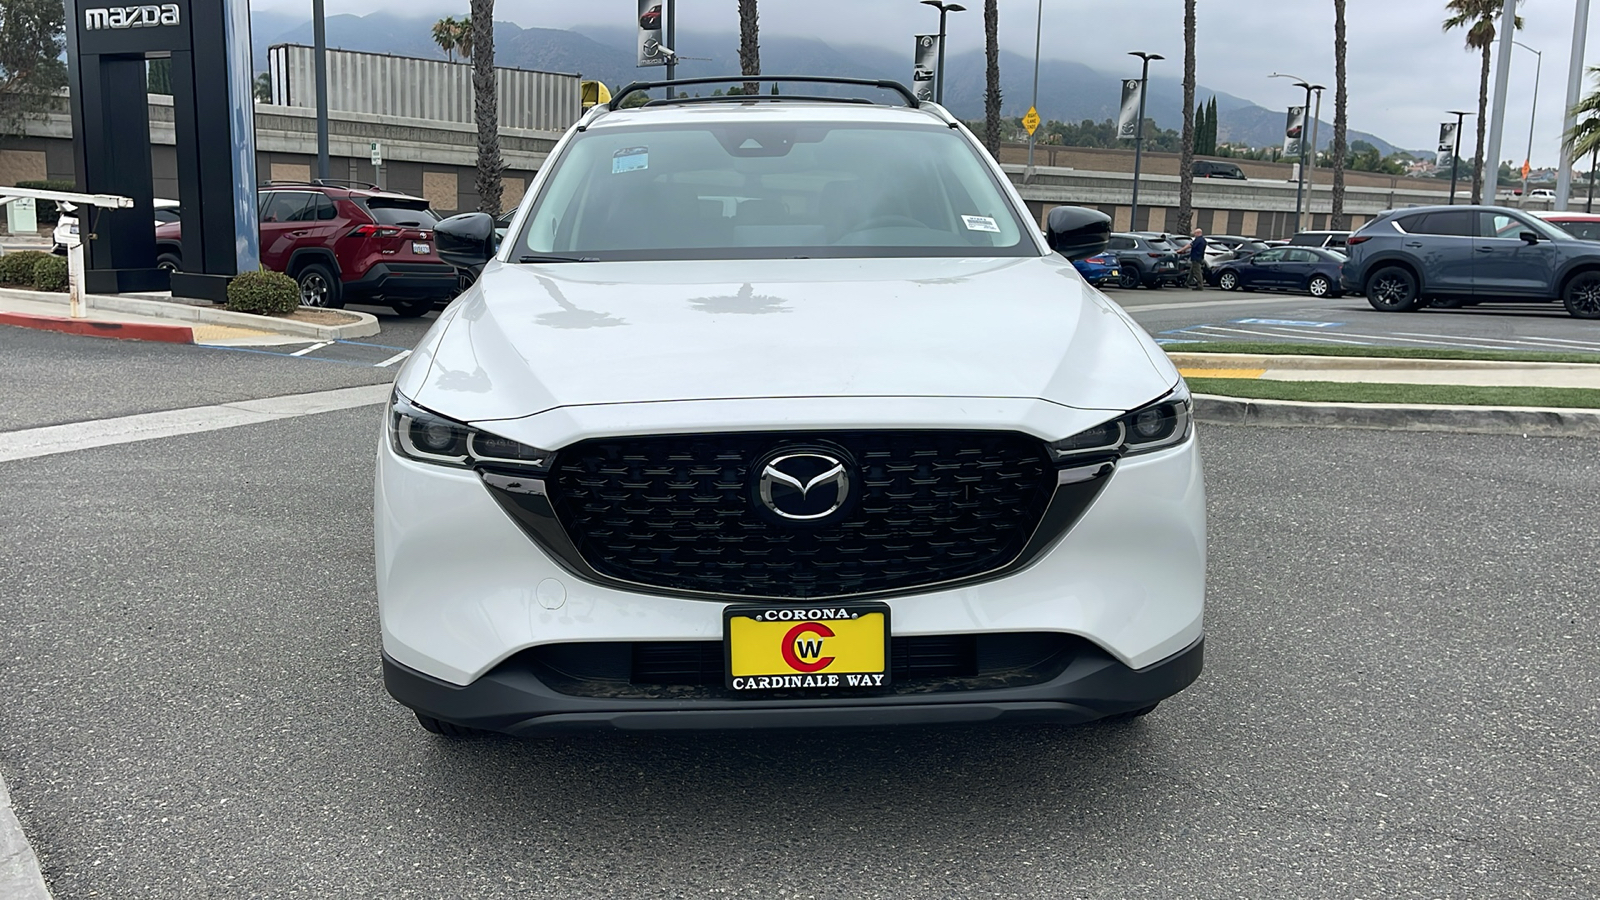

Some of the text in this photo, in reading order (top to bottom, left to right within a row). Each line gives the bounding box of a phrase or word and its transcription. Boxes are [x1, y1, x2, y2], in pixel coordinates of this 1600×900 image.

[764, 608, 850, 620] CORONA
[732, 674, 885, 690] CARDINALE WAY
